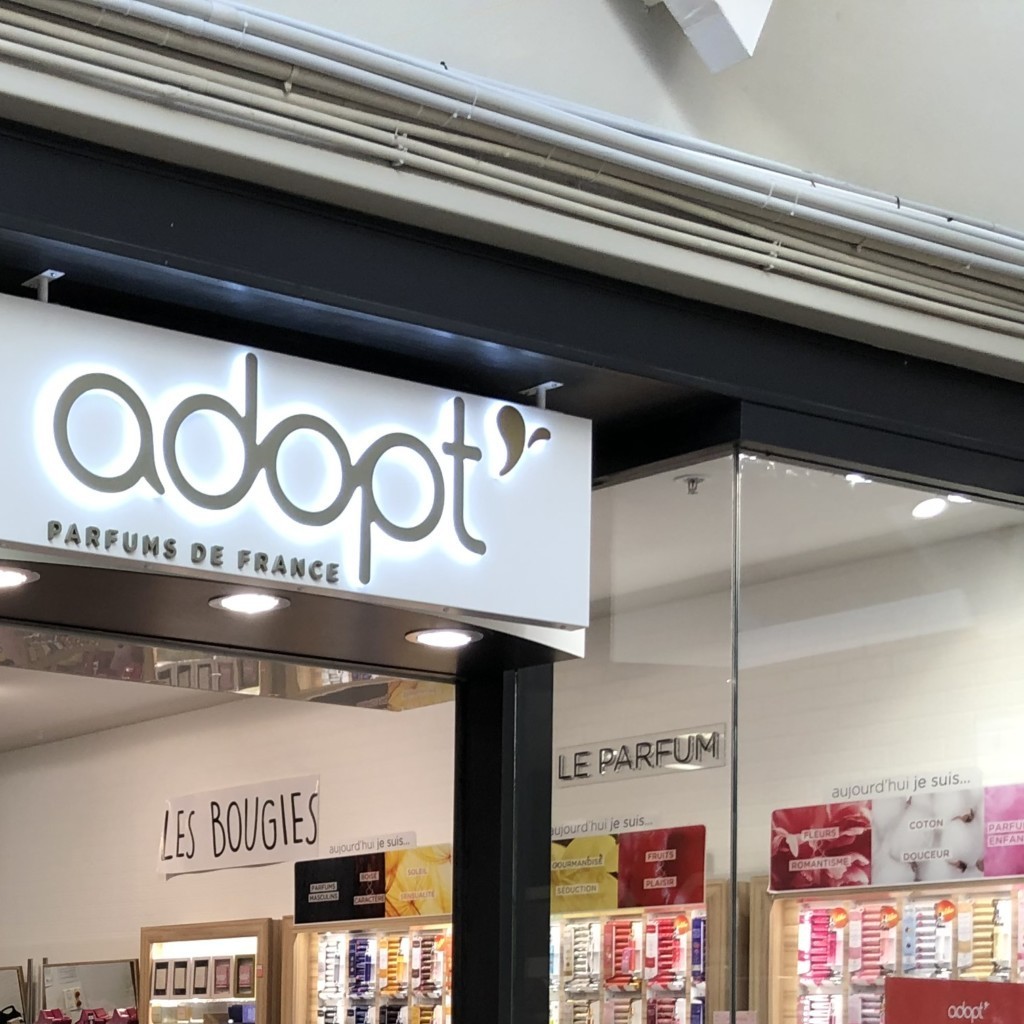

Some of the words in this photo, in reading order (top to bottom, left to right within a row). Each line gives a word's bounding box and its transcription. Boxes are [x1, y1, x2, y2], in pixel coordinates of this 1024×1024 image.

[47, 519, 177, 560] PARFUMS
[190, 541, 224, 568] DE
[237, 549, 340, 583] FRANCE
[558, 751, 591, 780] LE
[599, 731, 720, 774] PARFUM
[832, 779, 910, 799] aujourd'hui
[912, 776, 927, 793] je
[161, 810, 196, 862] LES
[211, 792, 319, 859] BOUGIES
[610, 819, 620, 832] je
[909, 819, 944, 830] COTON
[988, 822, 1024, 834] PARFU
[804, 829, 837, 839] FLEURS
[329, 839, 375, 855] aujourd'hui
[377, 838, 385, 850] je
[648, 851, 675, 860] FRUITS
[903, 850, 950, 862] DOUCEUR
[791, 857, 849, 870] ROMANTISME
[407, 868, 428, 877] SOLEIL
[645, 878, 675, 888] PLAISIR
[309, 892, 338, 901] MASCULINS
